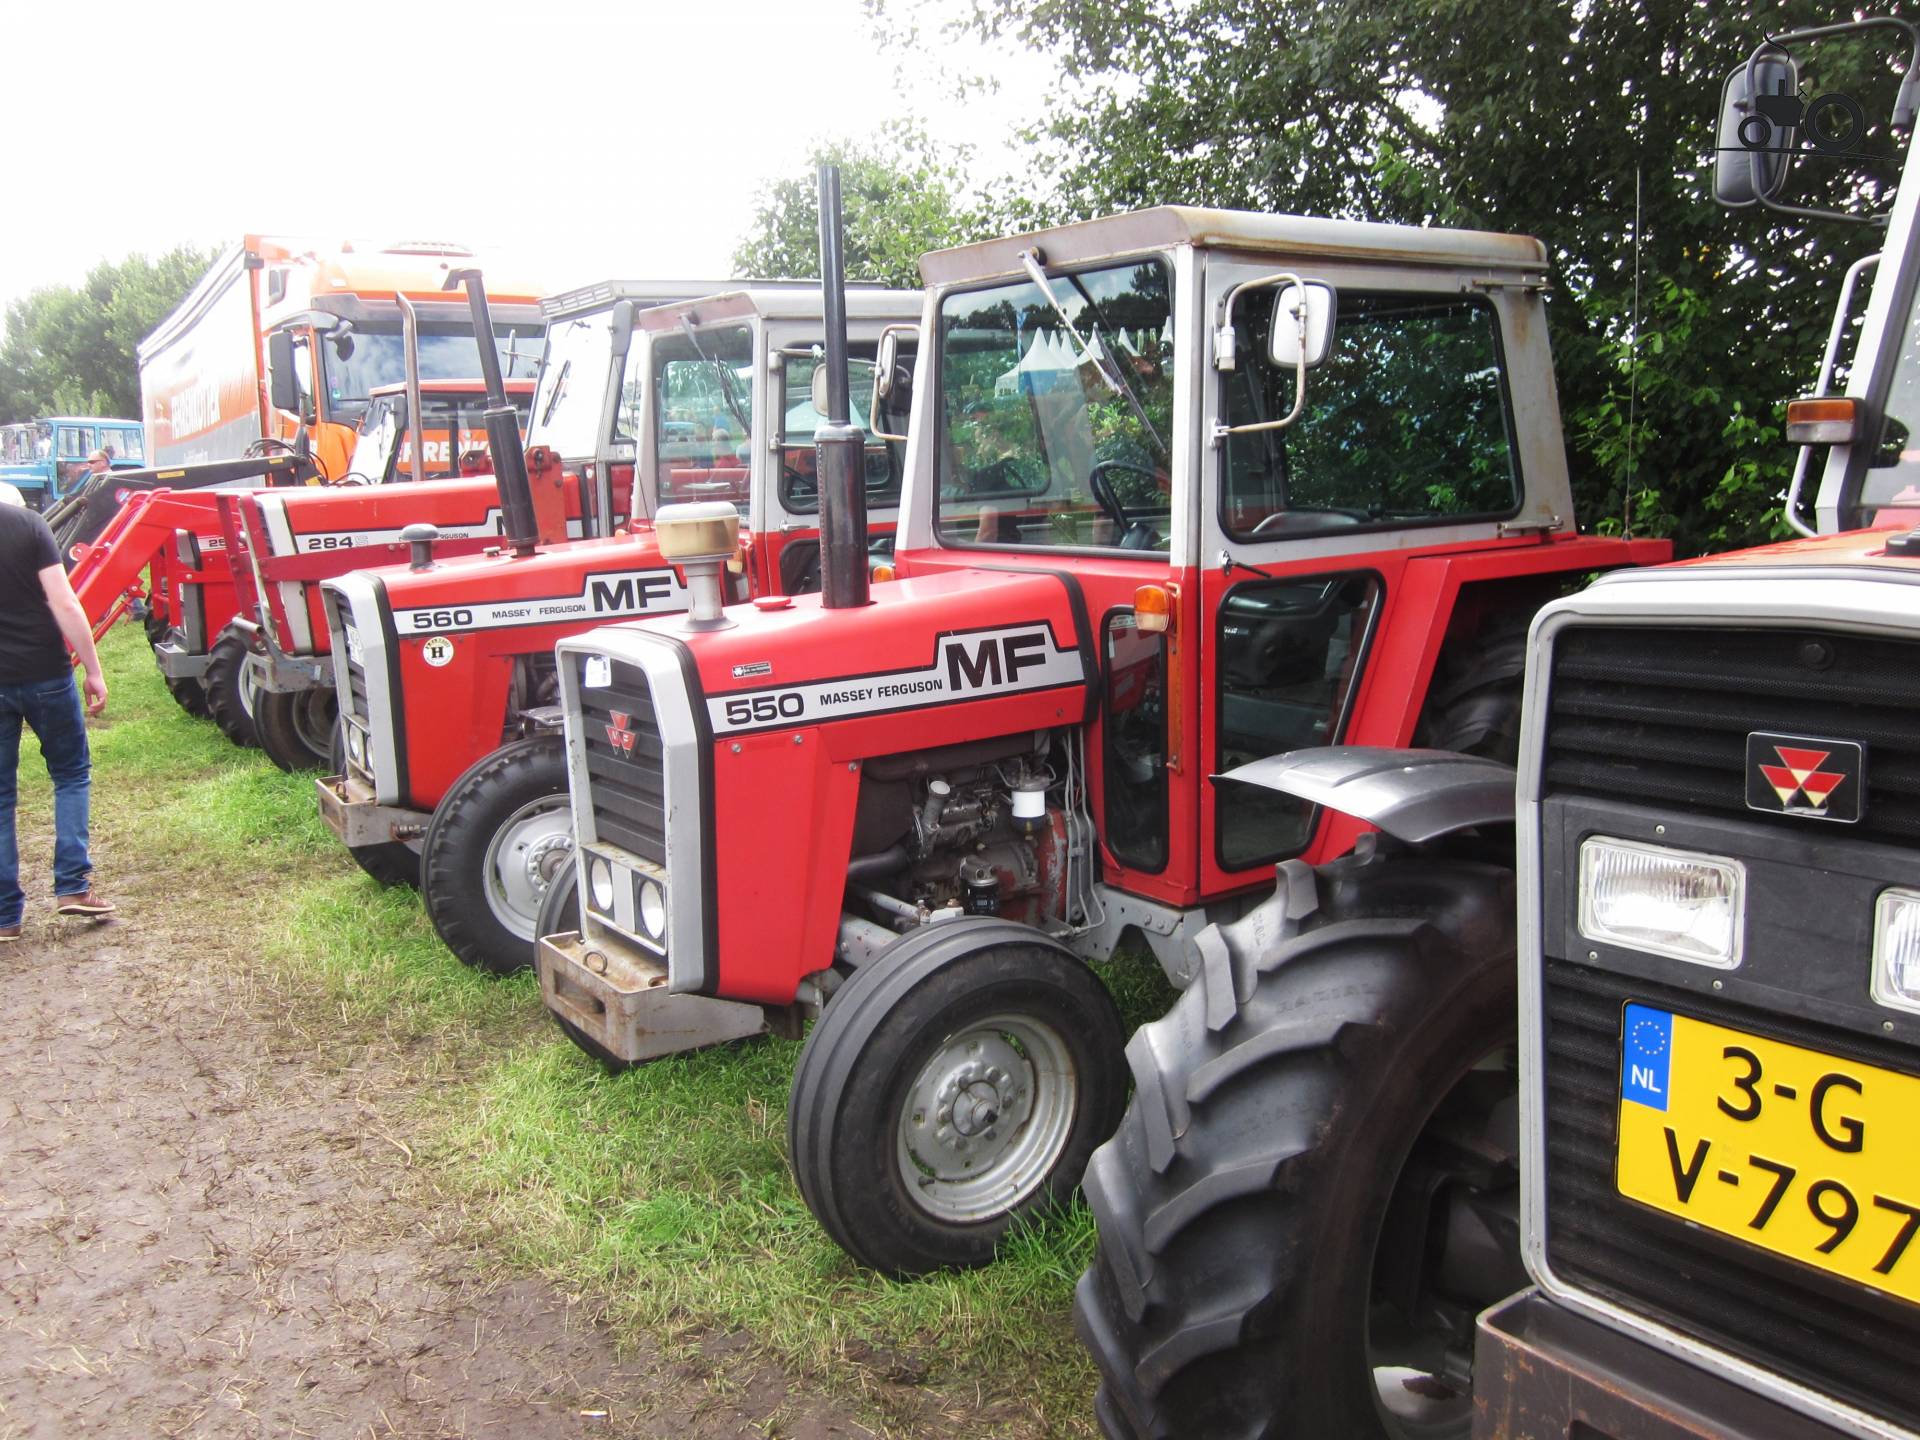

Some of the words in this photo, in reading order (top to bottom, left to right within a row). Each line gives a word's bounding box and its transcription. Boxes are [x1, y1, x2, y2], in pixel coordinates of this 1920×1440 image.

[413, 609, 473, 629] 560
[492, 608, 531, 619] MASSEY
[539, 604, 586, 615] FERGUSON
[591, 576, 671, 612] MF
[431, 646, 444, 658] H
[726, 692, 804, 725] 550
[820, 688, 873, 705] MASSEY
[878, 679, 943, 697] FERGUSON
[945, 633, 1046, 691] MF
[1631, 1064, 1661, 1093] NL
[1717, 1046, 1864, 1153] 3-G
[1663, 1126, 1920, 1275] V-797
